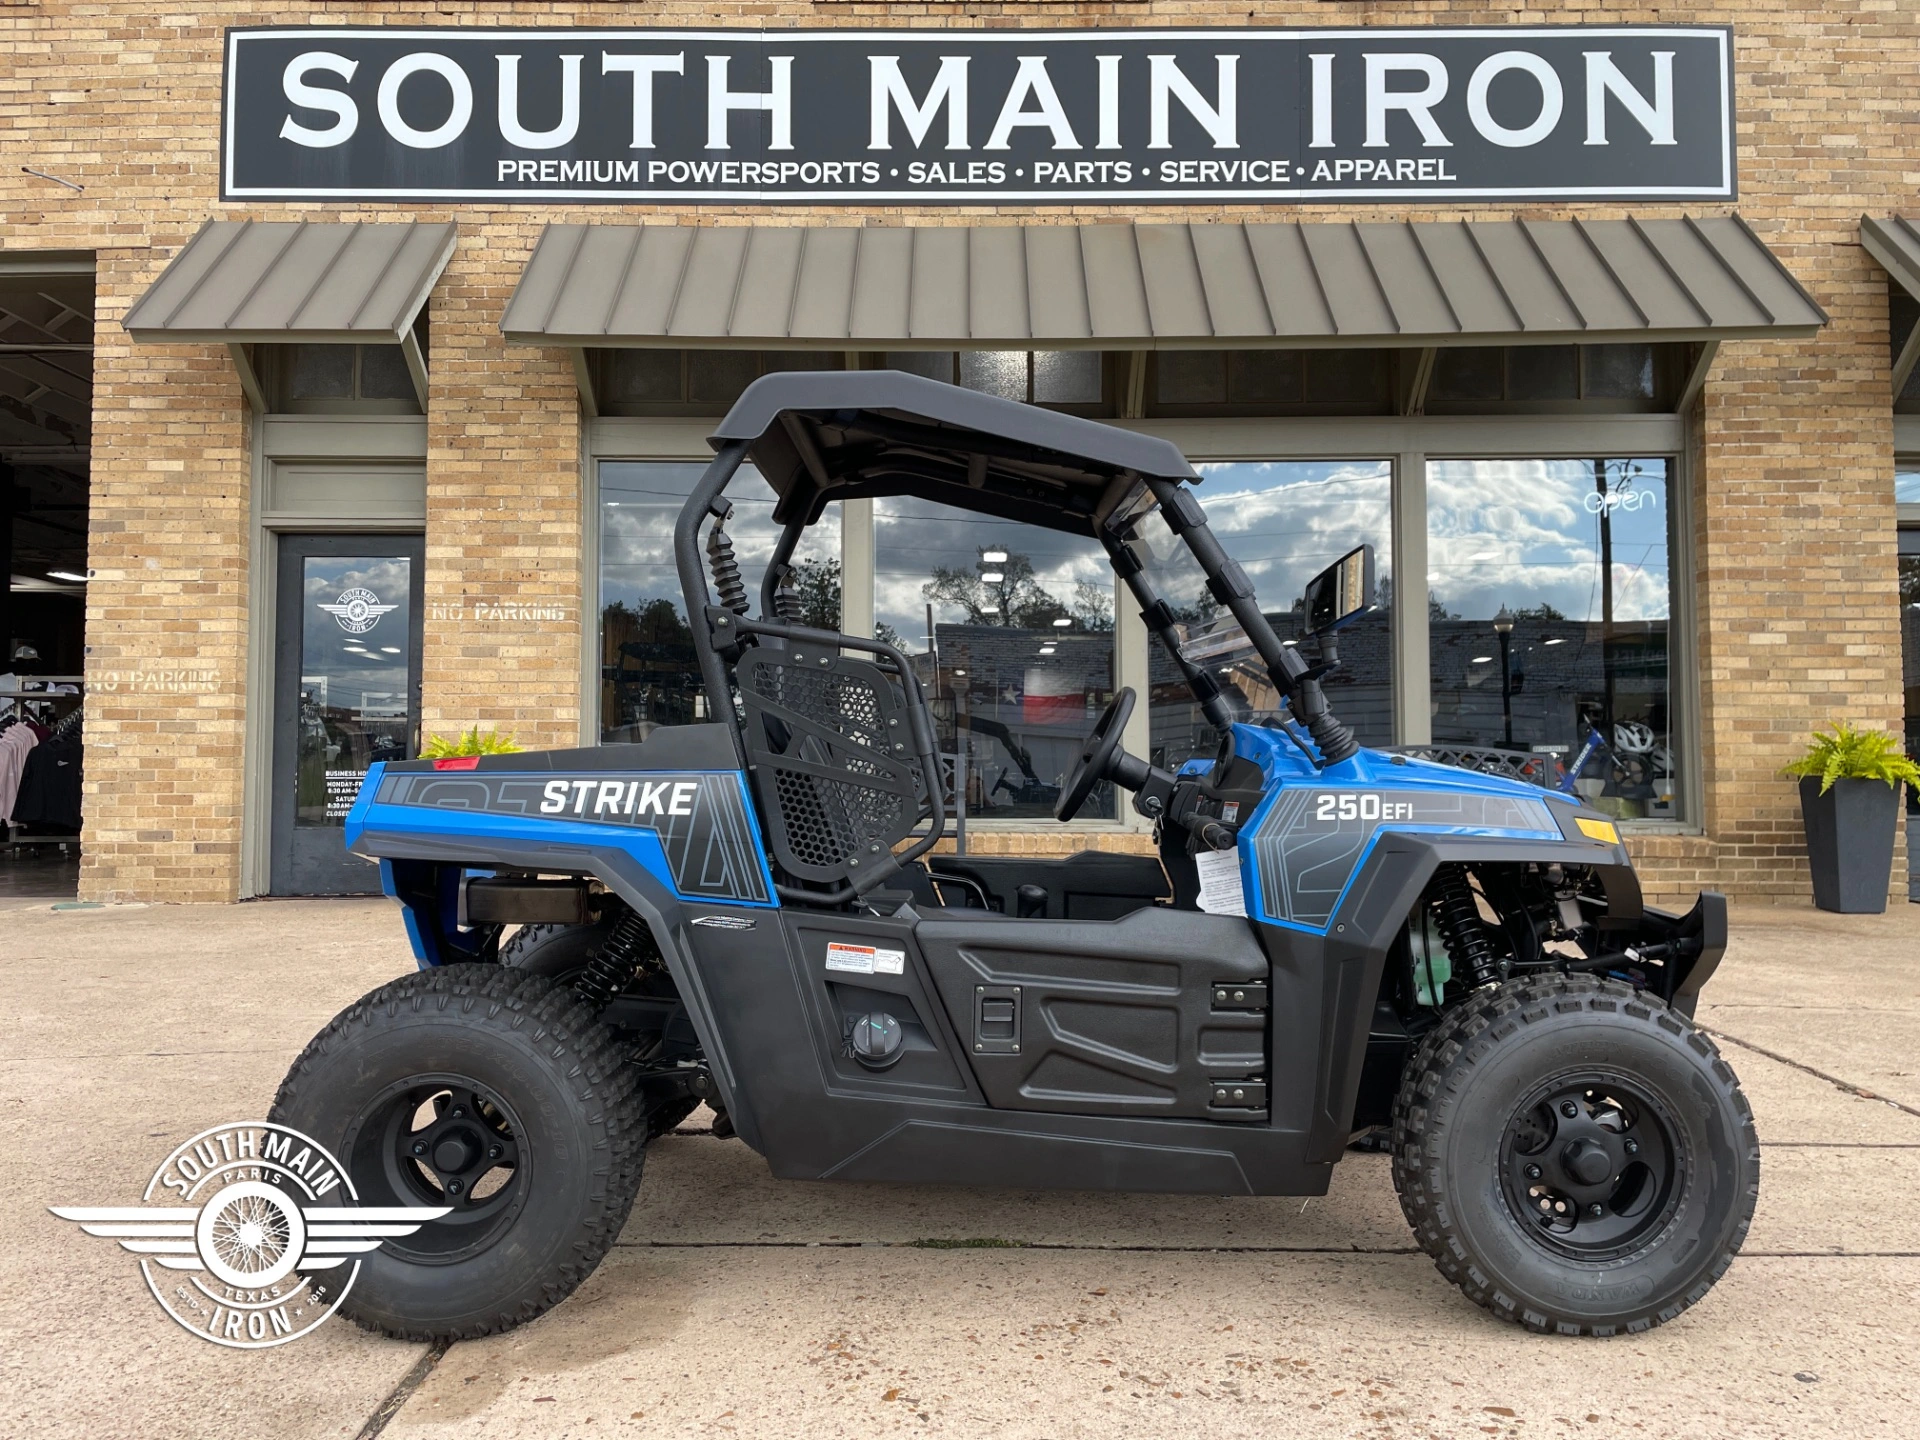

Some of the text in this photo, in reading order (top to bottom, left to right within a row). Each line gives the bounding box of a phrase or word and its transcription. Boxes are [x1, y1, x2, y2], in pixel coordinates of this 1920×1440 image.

[279, 51, 1678, 150] SOUTH MAIN IRON
[497, 159, 1456, 184] PREMIUM POWERSPORTS SALES PARTS SERVICE APPAREL
[1584, 490, 1656, 518] open
[340, 590, 360, 604] SOUTH
[432, 603, 565, 621] NO PARKING
[87, 671, 220, 691] NO PARKING
[540, 780, 697, 816] STRIKE
